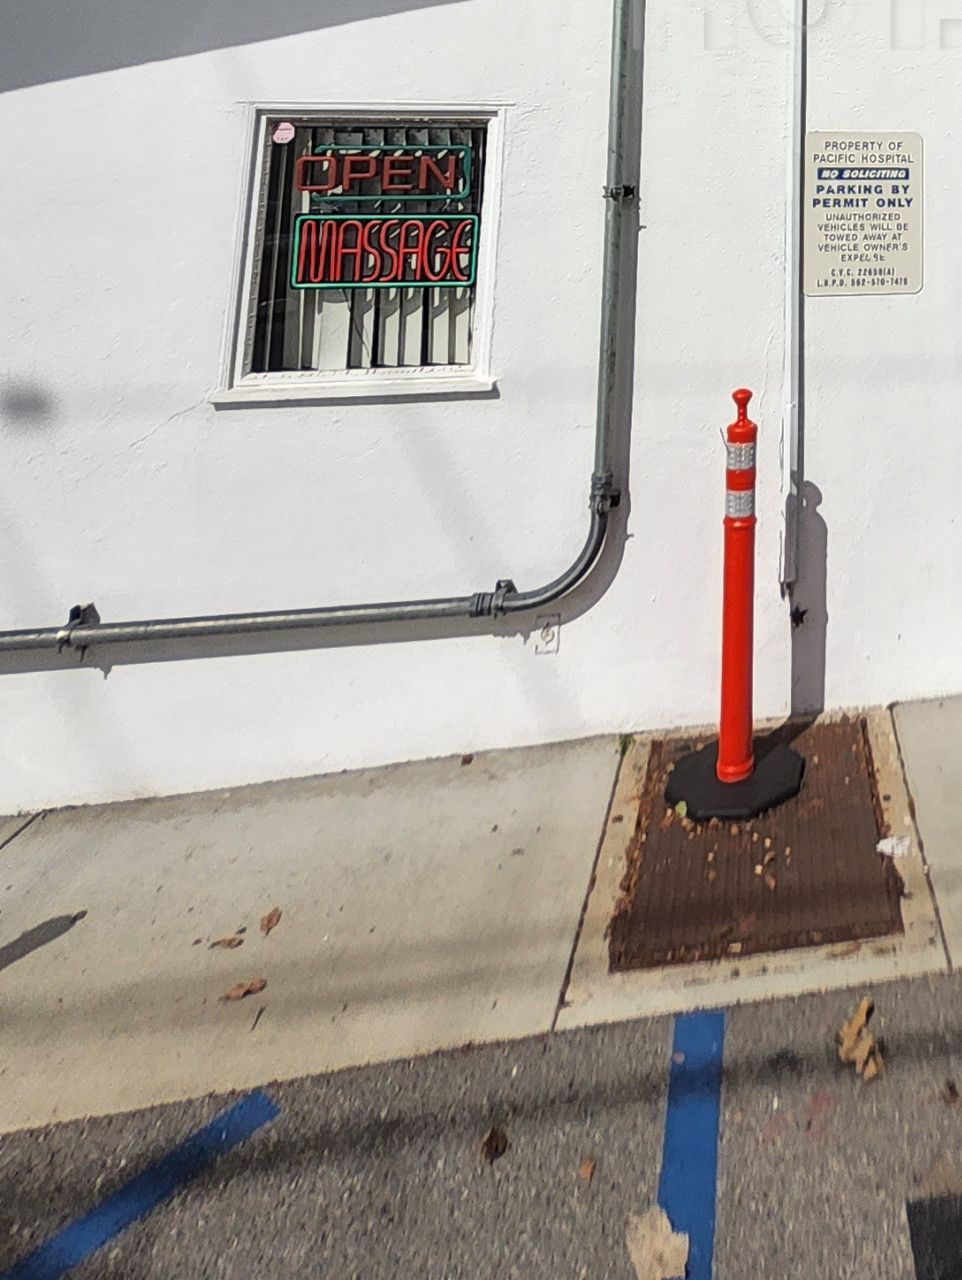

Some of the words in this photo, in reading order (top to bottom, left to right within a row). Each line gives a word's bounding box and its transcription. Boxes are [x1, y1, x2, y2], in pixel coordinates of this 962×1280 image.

[825, 142, 883, 150] PROPERTY
[889, 142, 903, 150] OF
[813, 154, 855, 163] PACIFIC
[861, 154, 914, 163] HOSPITAL
[294, 155, 456, 192] OPEN
[820, 169, 839, 178] NO
[843, 169, 906, 178] SOLICITING
[816, 185, 883, 194] PARKING
[892, 185, 911, 194] BY
[812, 198, 868, 208] PERMIT
[876, 198, 913, 207] ONLY
[826, 213, 901, 221] UNAUTHORIZED
[870, 223, 892, 231] WILL
[896, 223, 909, 231] BE
[863, 233, 888, 241] AWAY
[892, 233, 902, 241] AT
[298, 220, 472, 282] MASSAGE
[864, 243, 908, 251] OWNER'S
